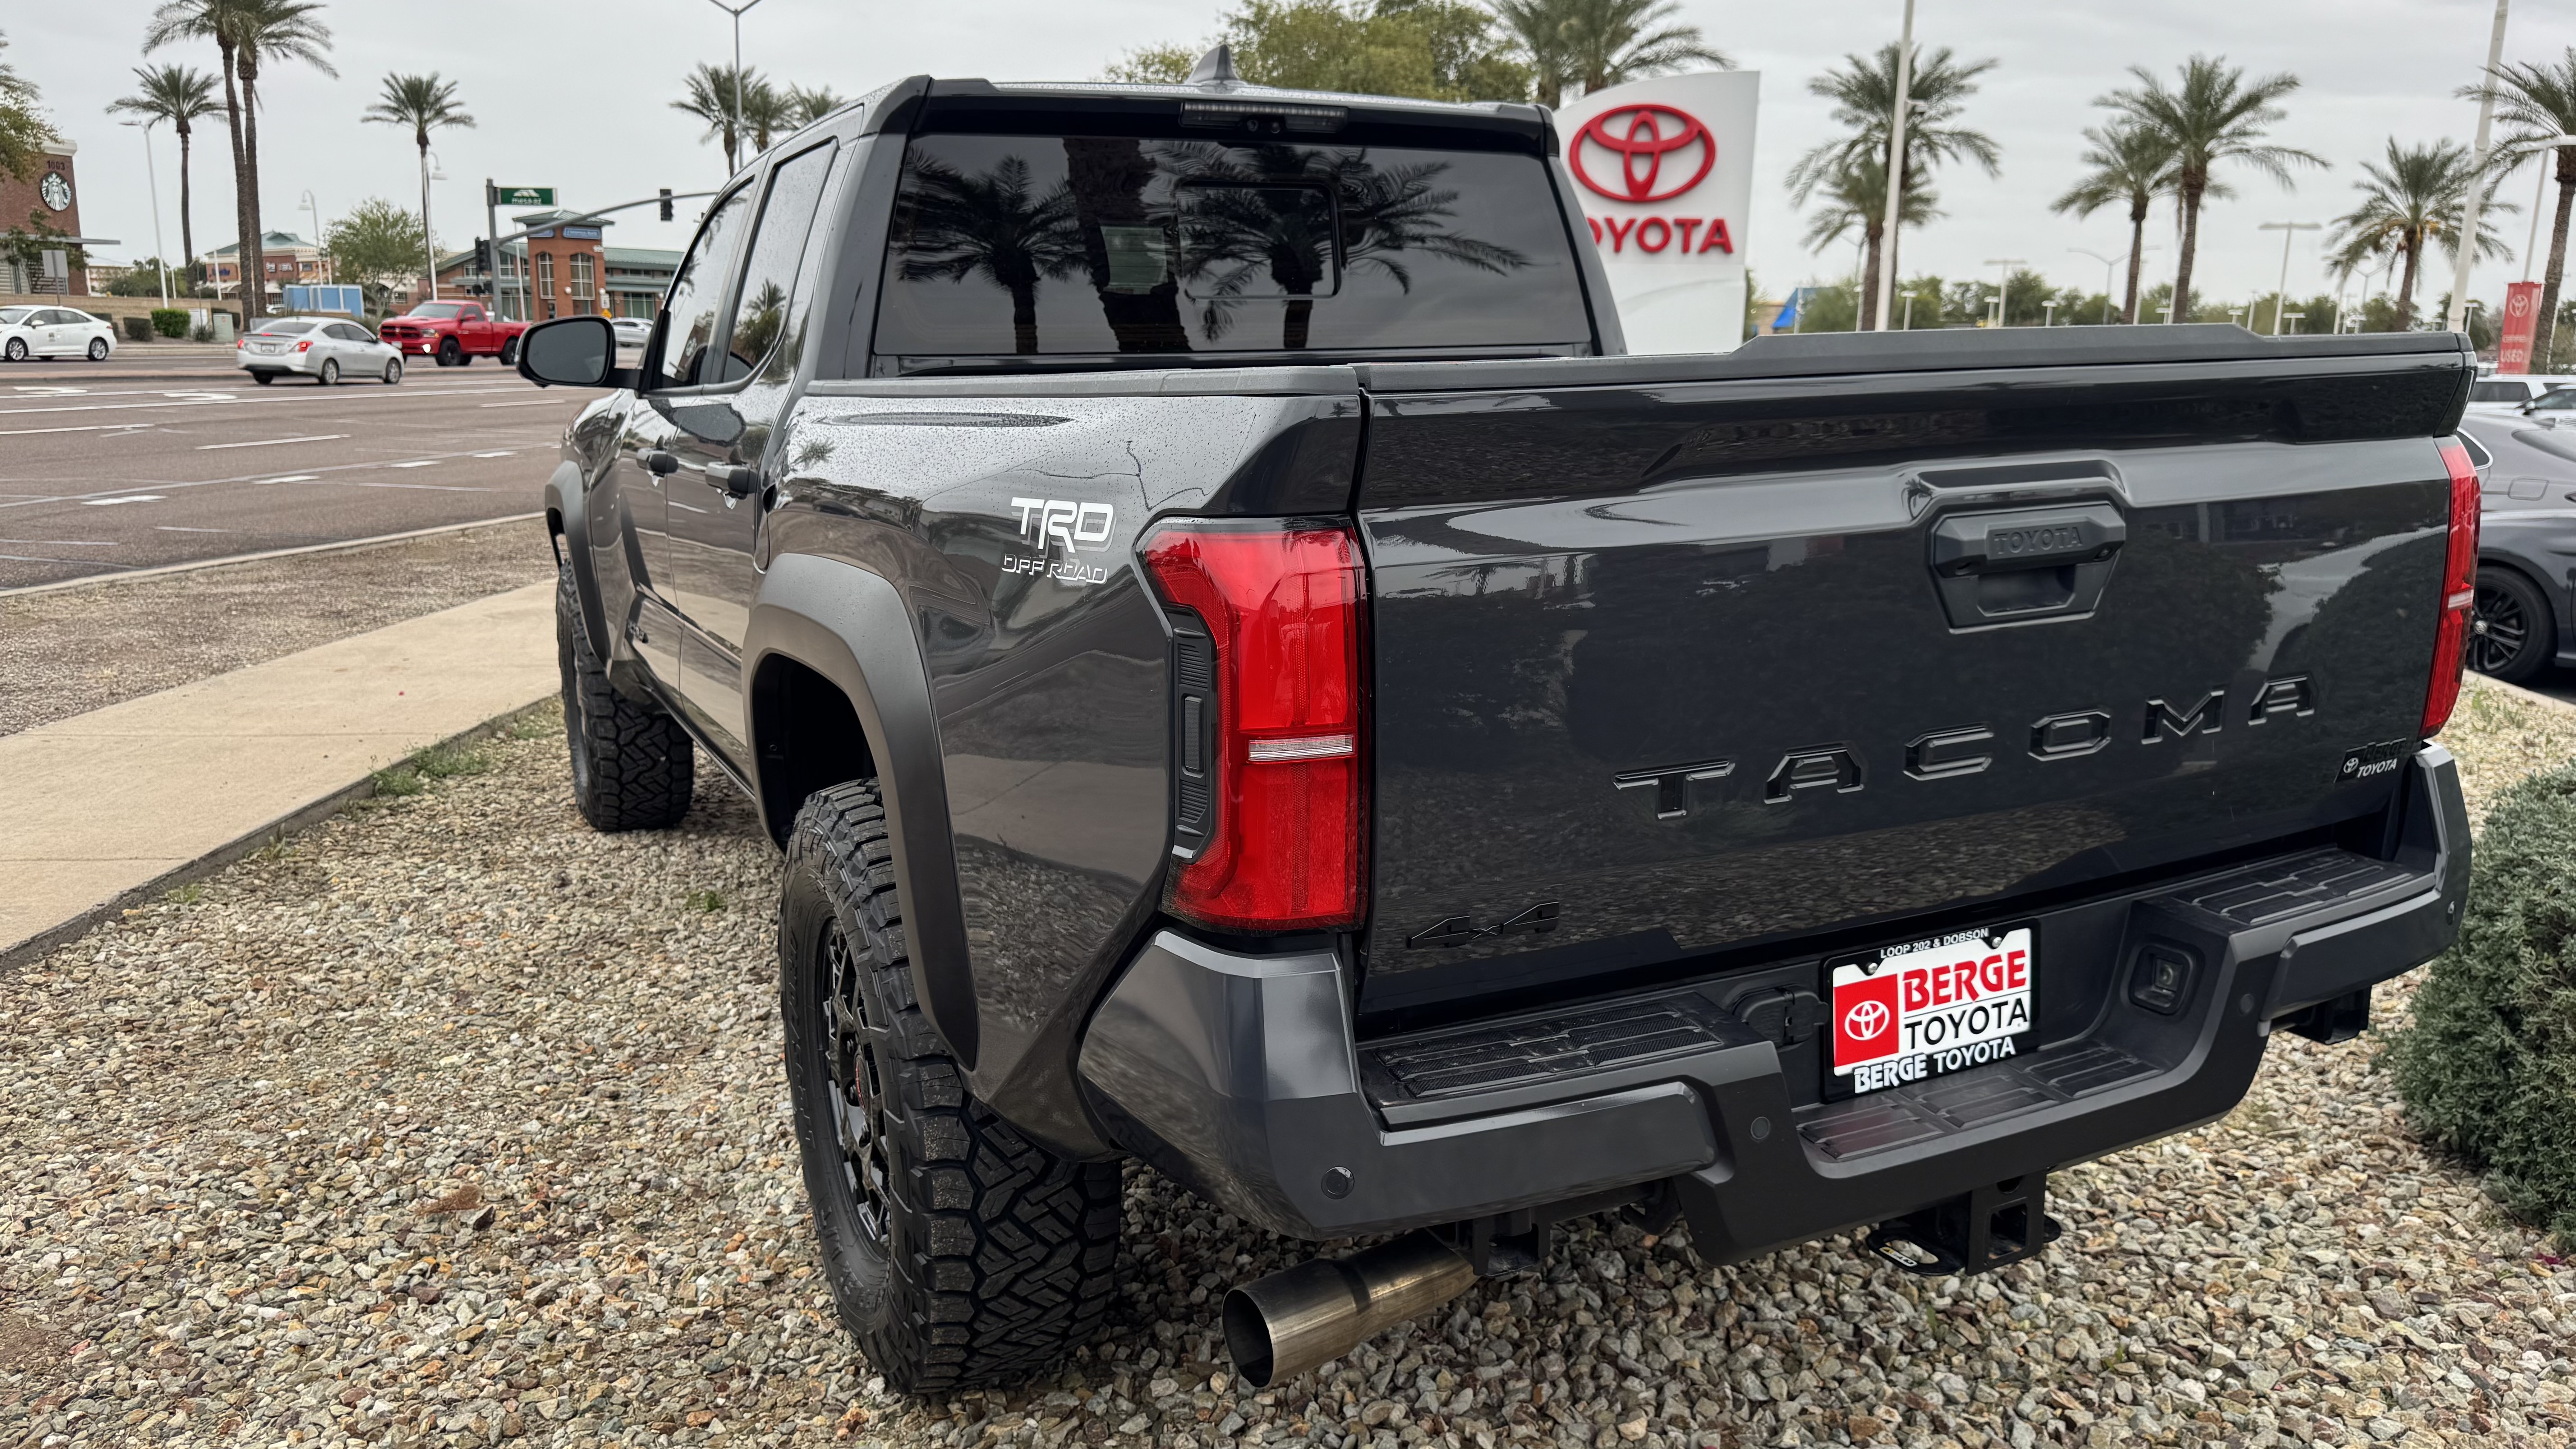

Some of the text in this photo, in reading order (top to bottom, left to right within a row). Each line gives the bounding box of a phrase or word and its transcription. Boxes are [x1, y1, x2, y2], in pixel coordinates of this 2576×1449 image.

[1586, 217, 1733, 253] YOTA
[1011, 497, 1114, 553] TRD
[1994, 527, 2082, 554] TOYOTA
[1002, 553, 1108, 584] OFF ROAD
[1612, 672, 2314, 820] TACOMA
[2357, 758, 2397, 778] TOYOTA
[1880, 927, 1989, 959] LOOP 202 & DOBSON
[1903, 949, 2027, 1012] BERGE
[1904, 997, 2029, 1050] TOYOTA
[1854, 1036, 2016, 1094] BERGE TOYOTA
